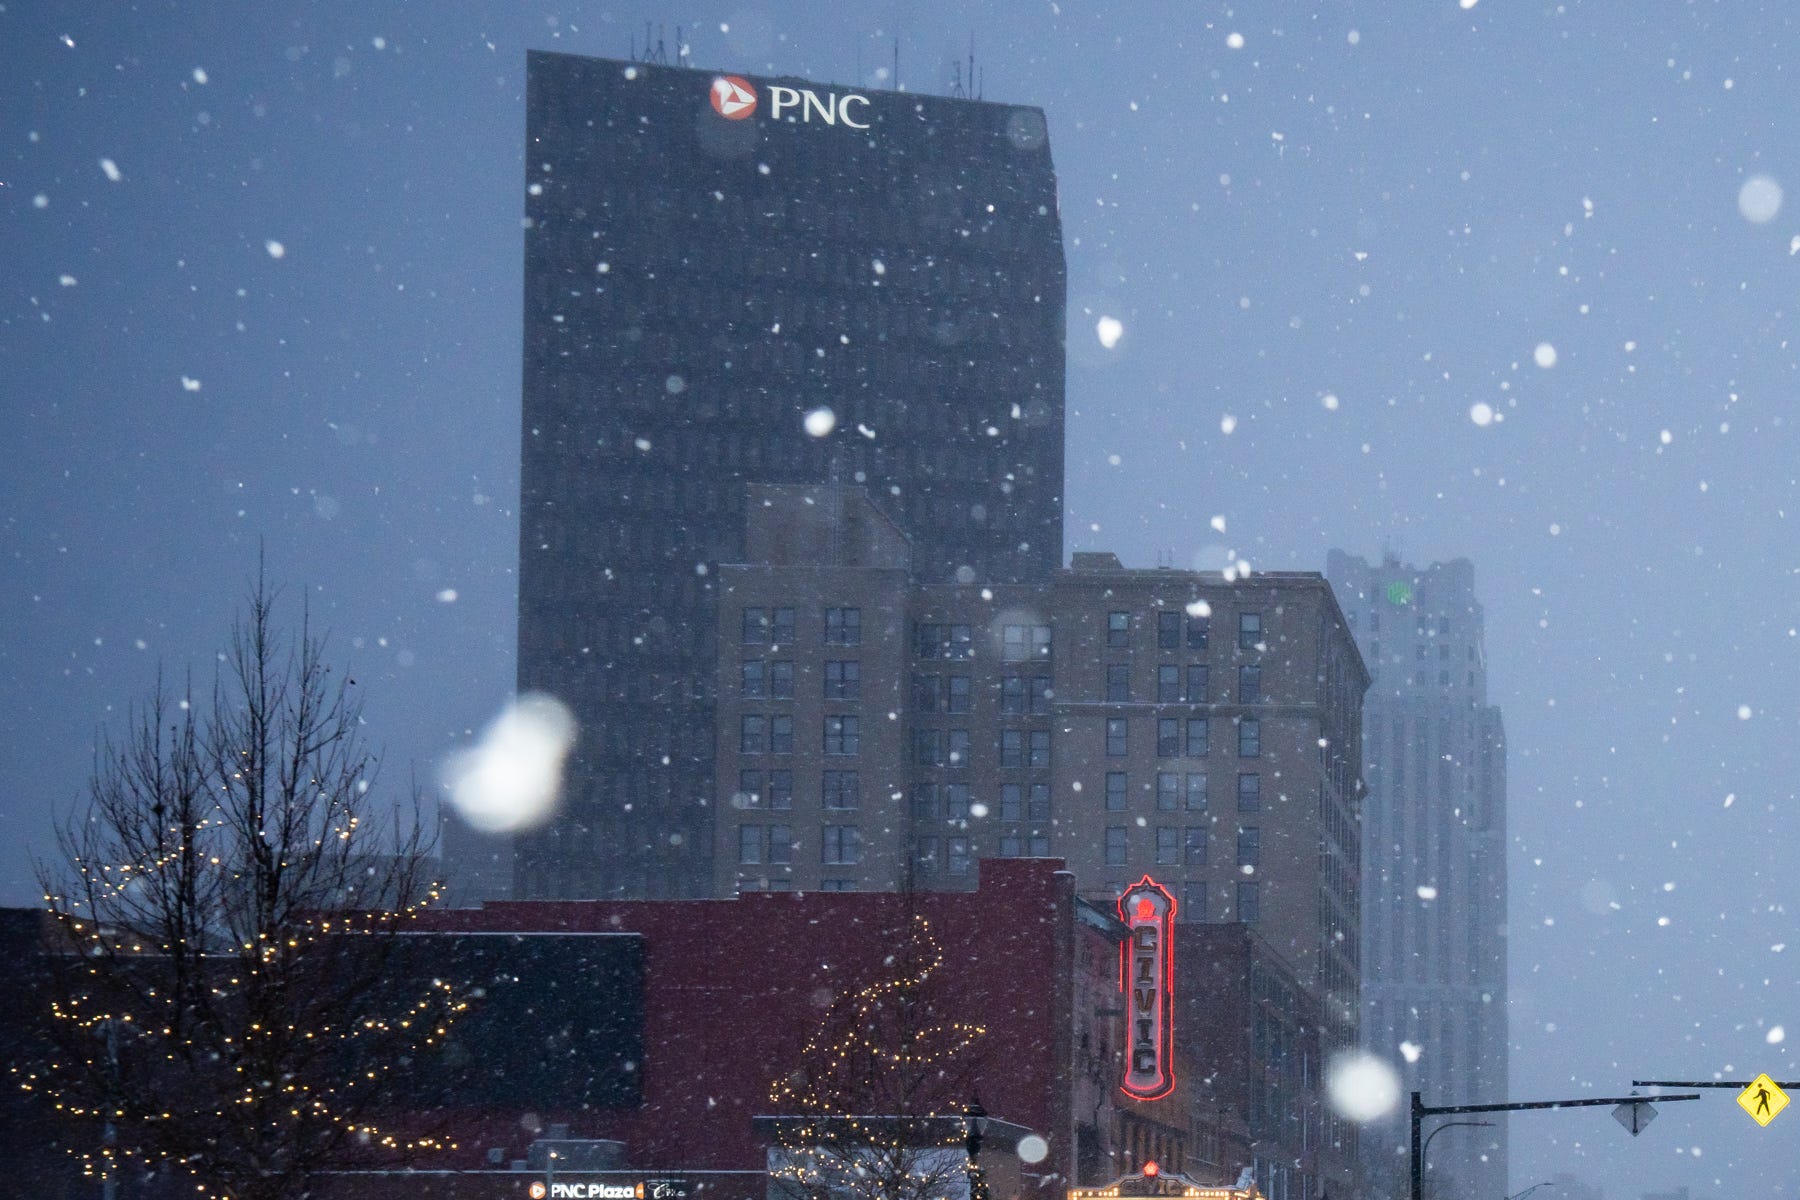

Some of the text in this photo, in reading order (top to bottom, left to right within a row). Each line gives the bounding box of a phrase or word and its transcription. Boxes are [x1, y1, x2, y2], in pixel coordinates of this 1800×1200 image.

[767, 86, 871, 129] PNC
[1133, 925, 1157, 1075] CIVIC
[551, 1183, 586, 1198] PNC
[588, 1183, 635, 1198] Plaza
